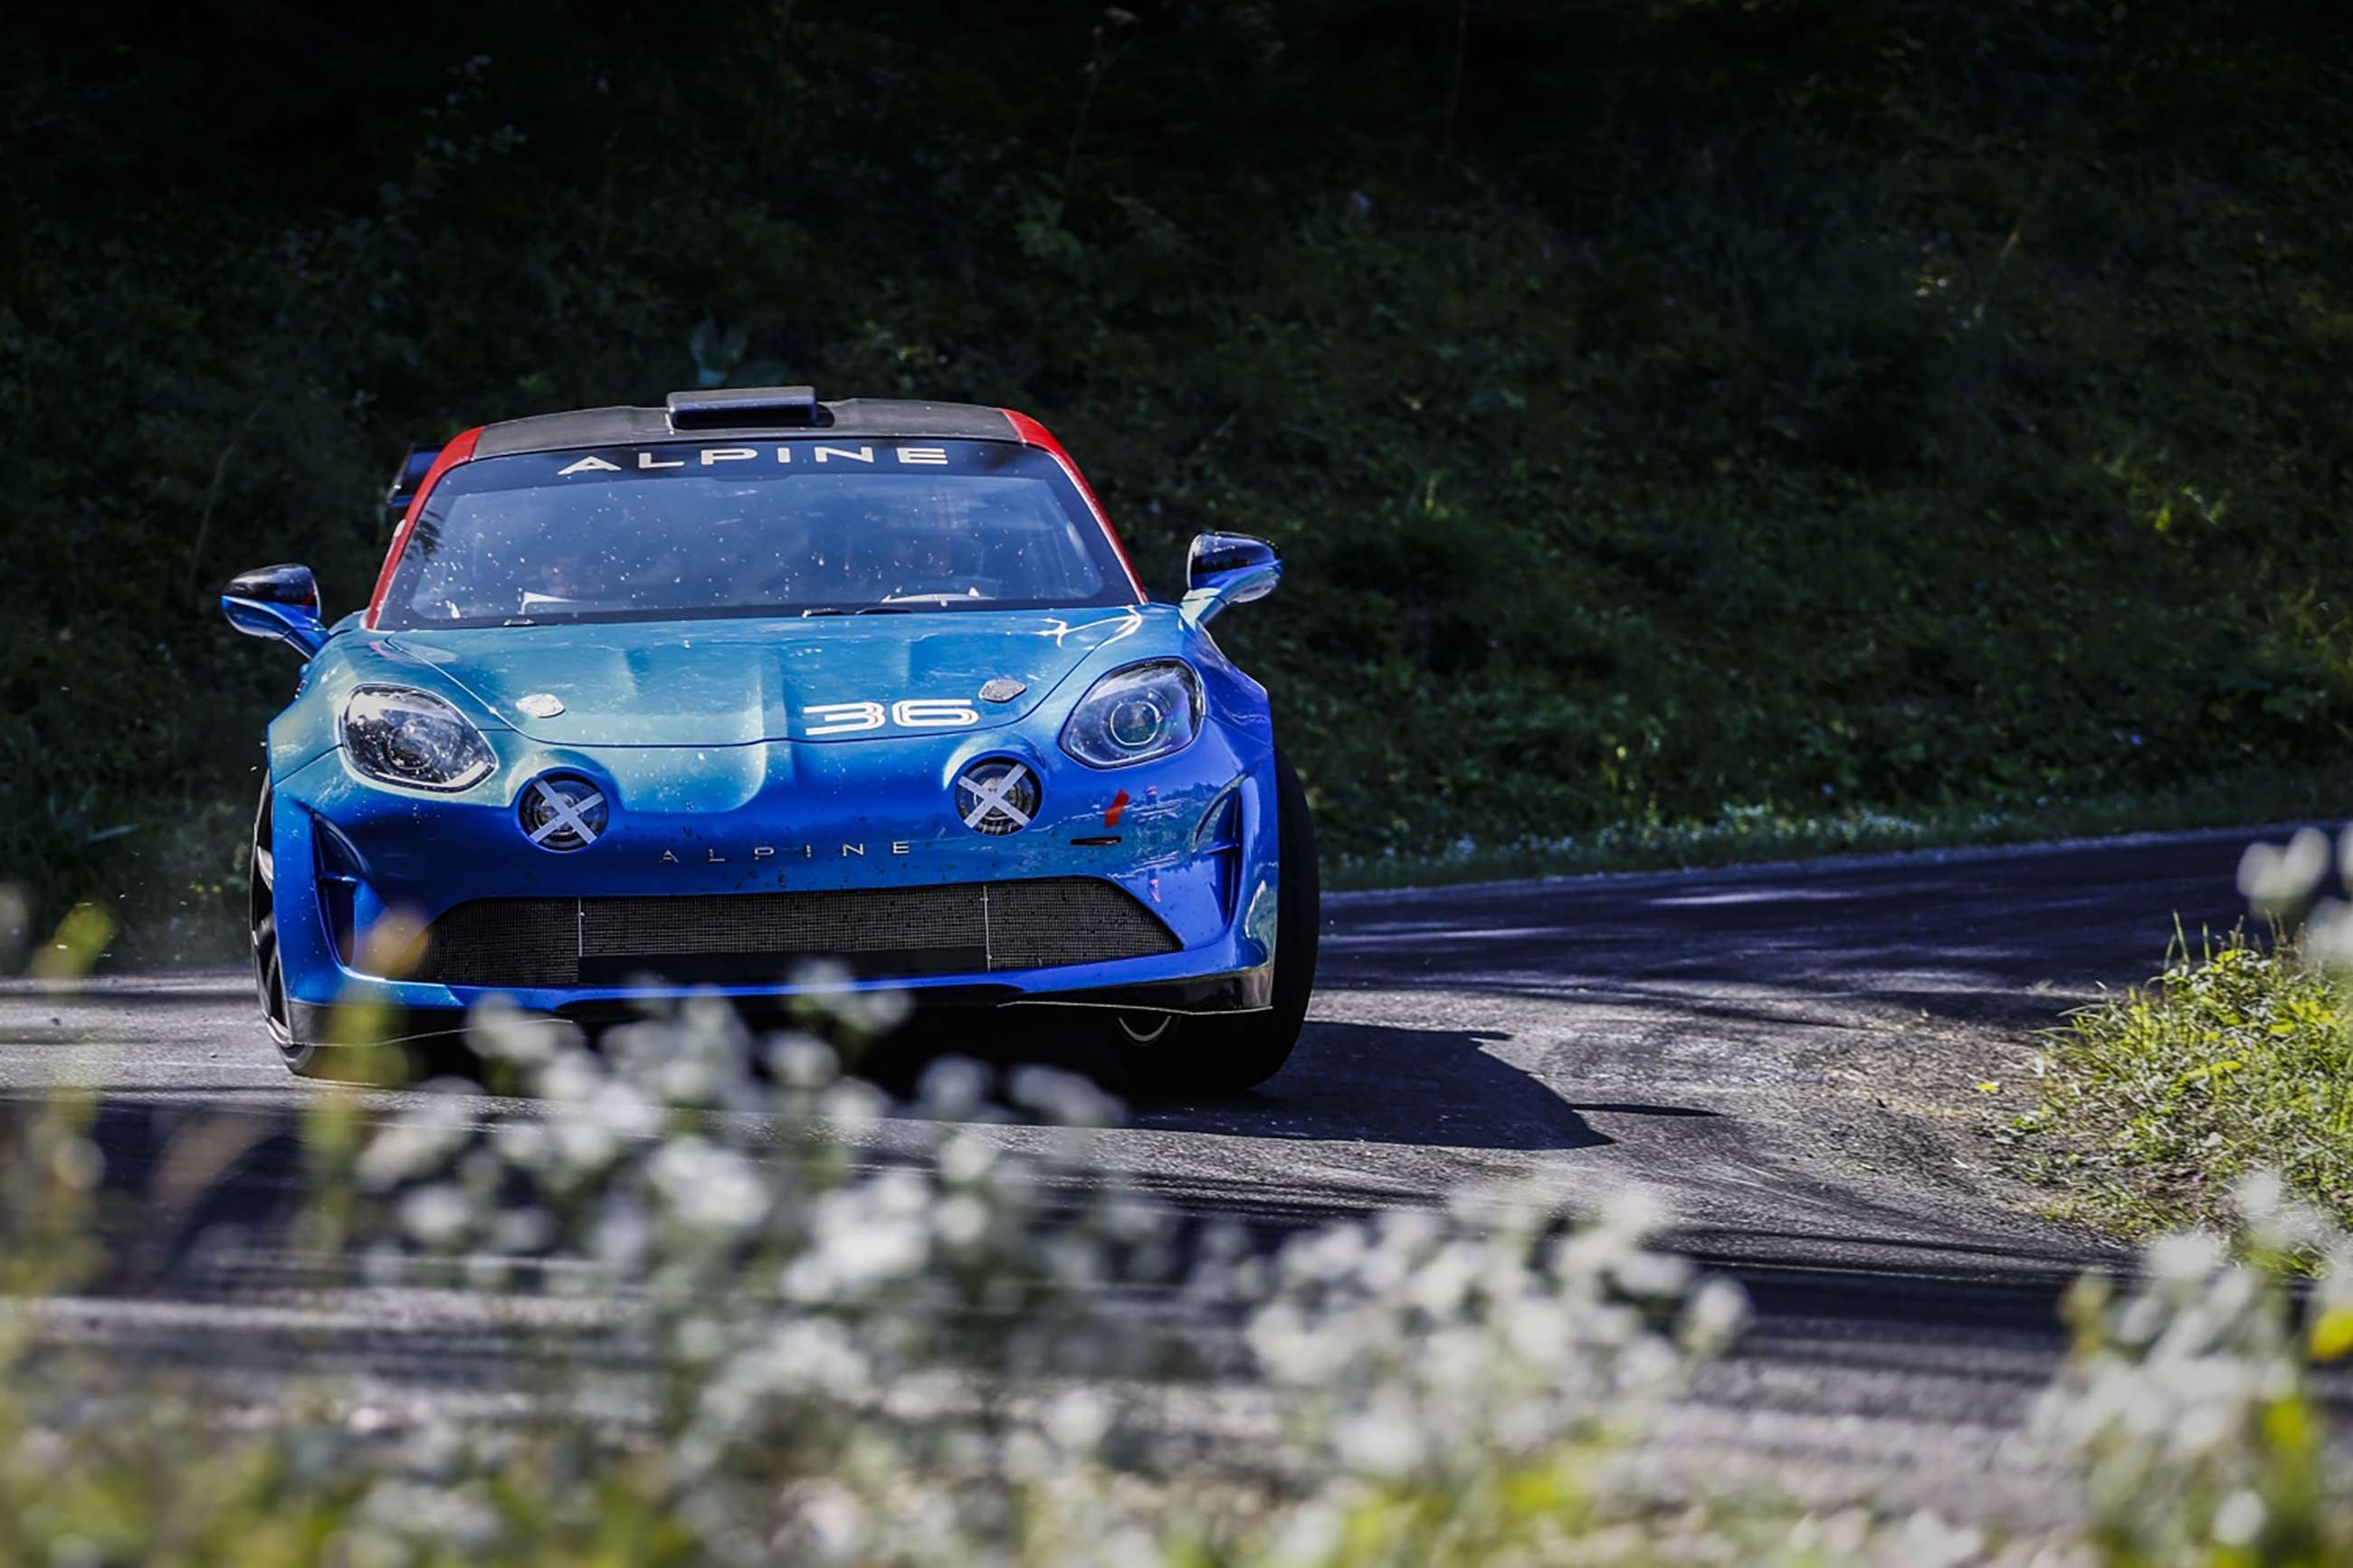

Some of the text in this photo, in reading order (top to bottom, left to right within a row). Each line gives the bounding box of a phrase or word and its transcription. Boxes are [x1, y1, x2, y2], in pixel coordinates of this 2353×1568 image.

[557, 446, 949, 476] ALPINE
[802, 698, 980, 736] 36
[658, 841, 911, 864] ALPINE
